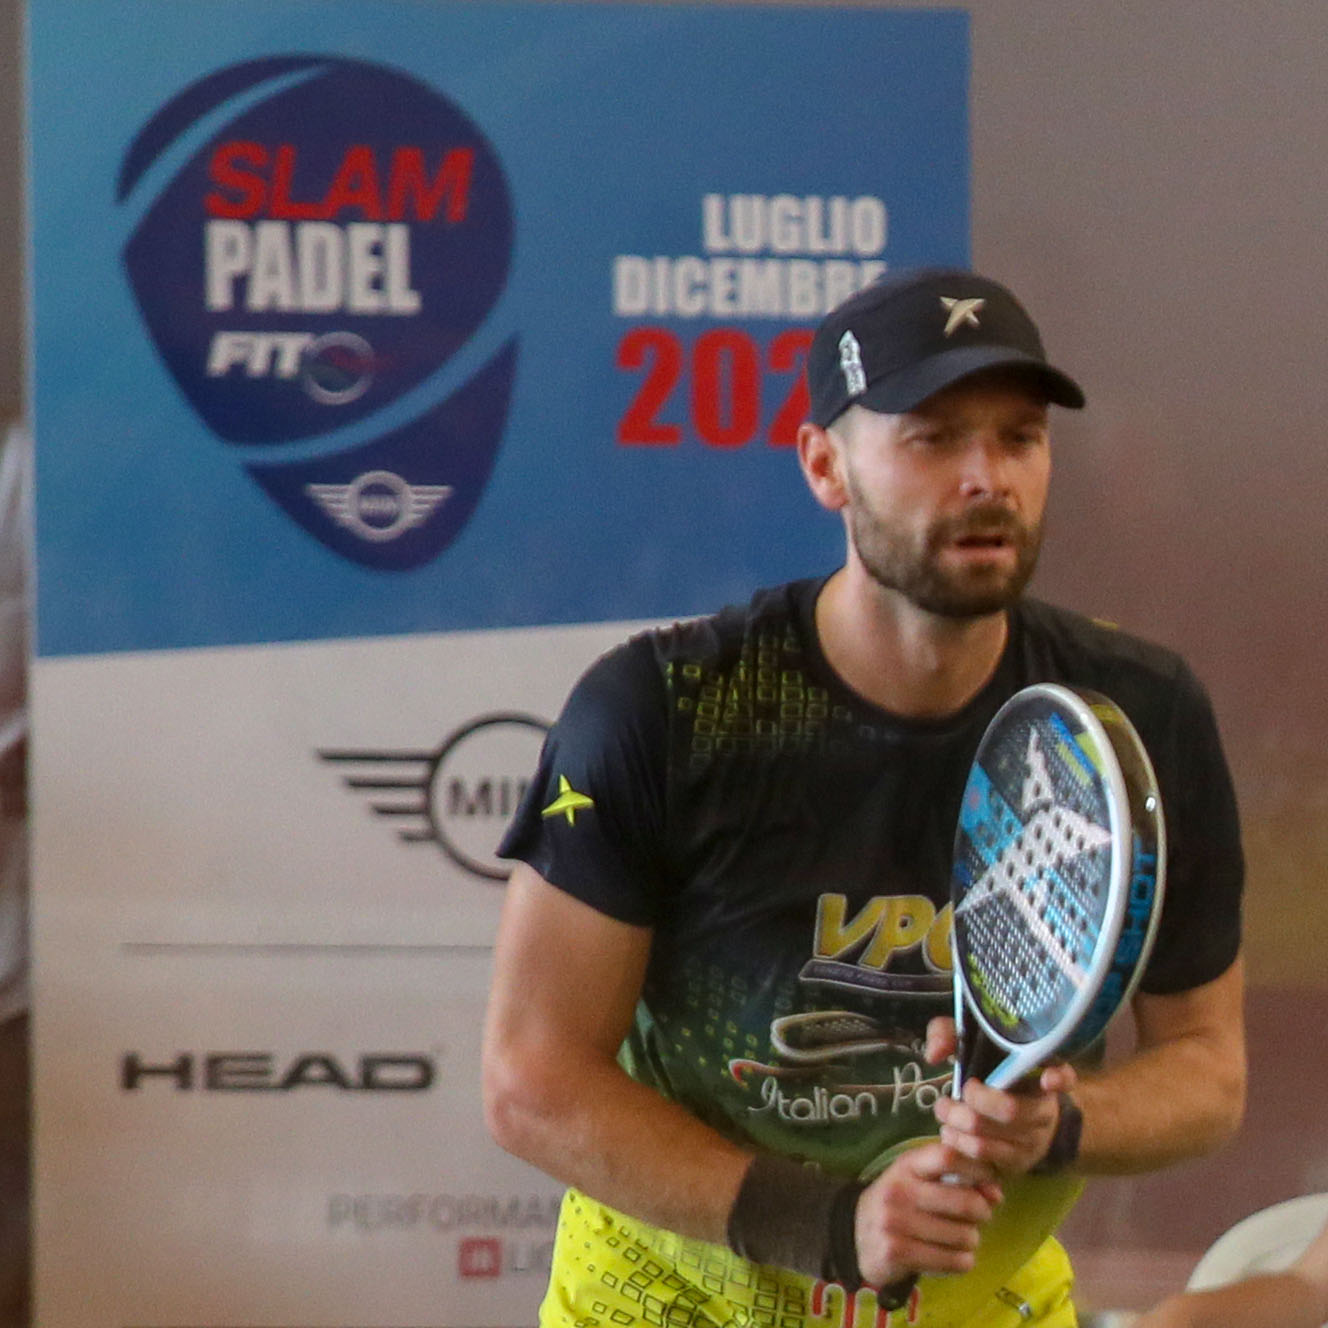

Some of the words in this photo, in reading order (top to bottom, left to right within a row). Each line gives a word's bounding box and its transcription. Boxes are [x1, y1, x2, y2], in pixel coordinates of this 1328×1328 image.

[205, 142, 475, 222] SLAM
[703, 196, 886, 257] LUGLIO
[207, 222, 420, 315] PADEL
[614, 258, 886, 316] DICEMBR
[208, 332, 310, 377] FIT
[617, 329, 812, 449] 202
[123, 1052, 437, 1091] HEAD
[748, 1077, 878, 1121] Italian
